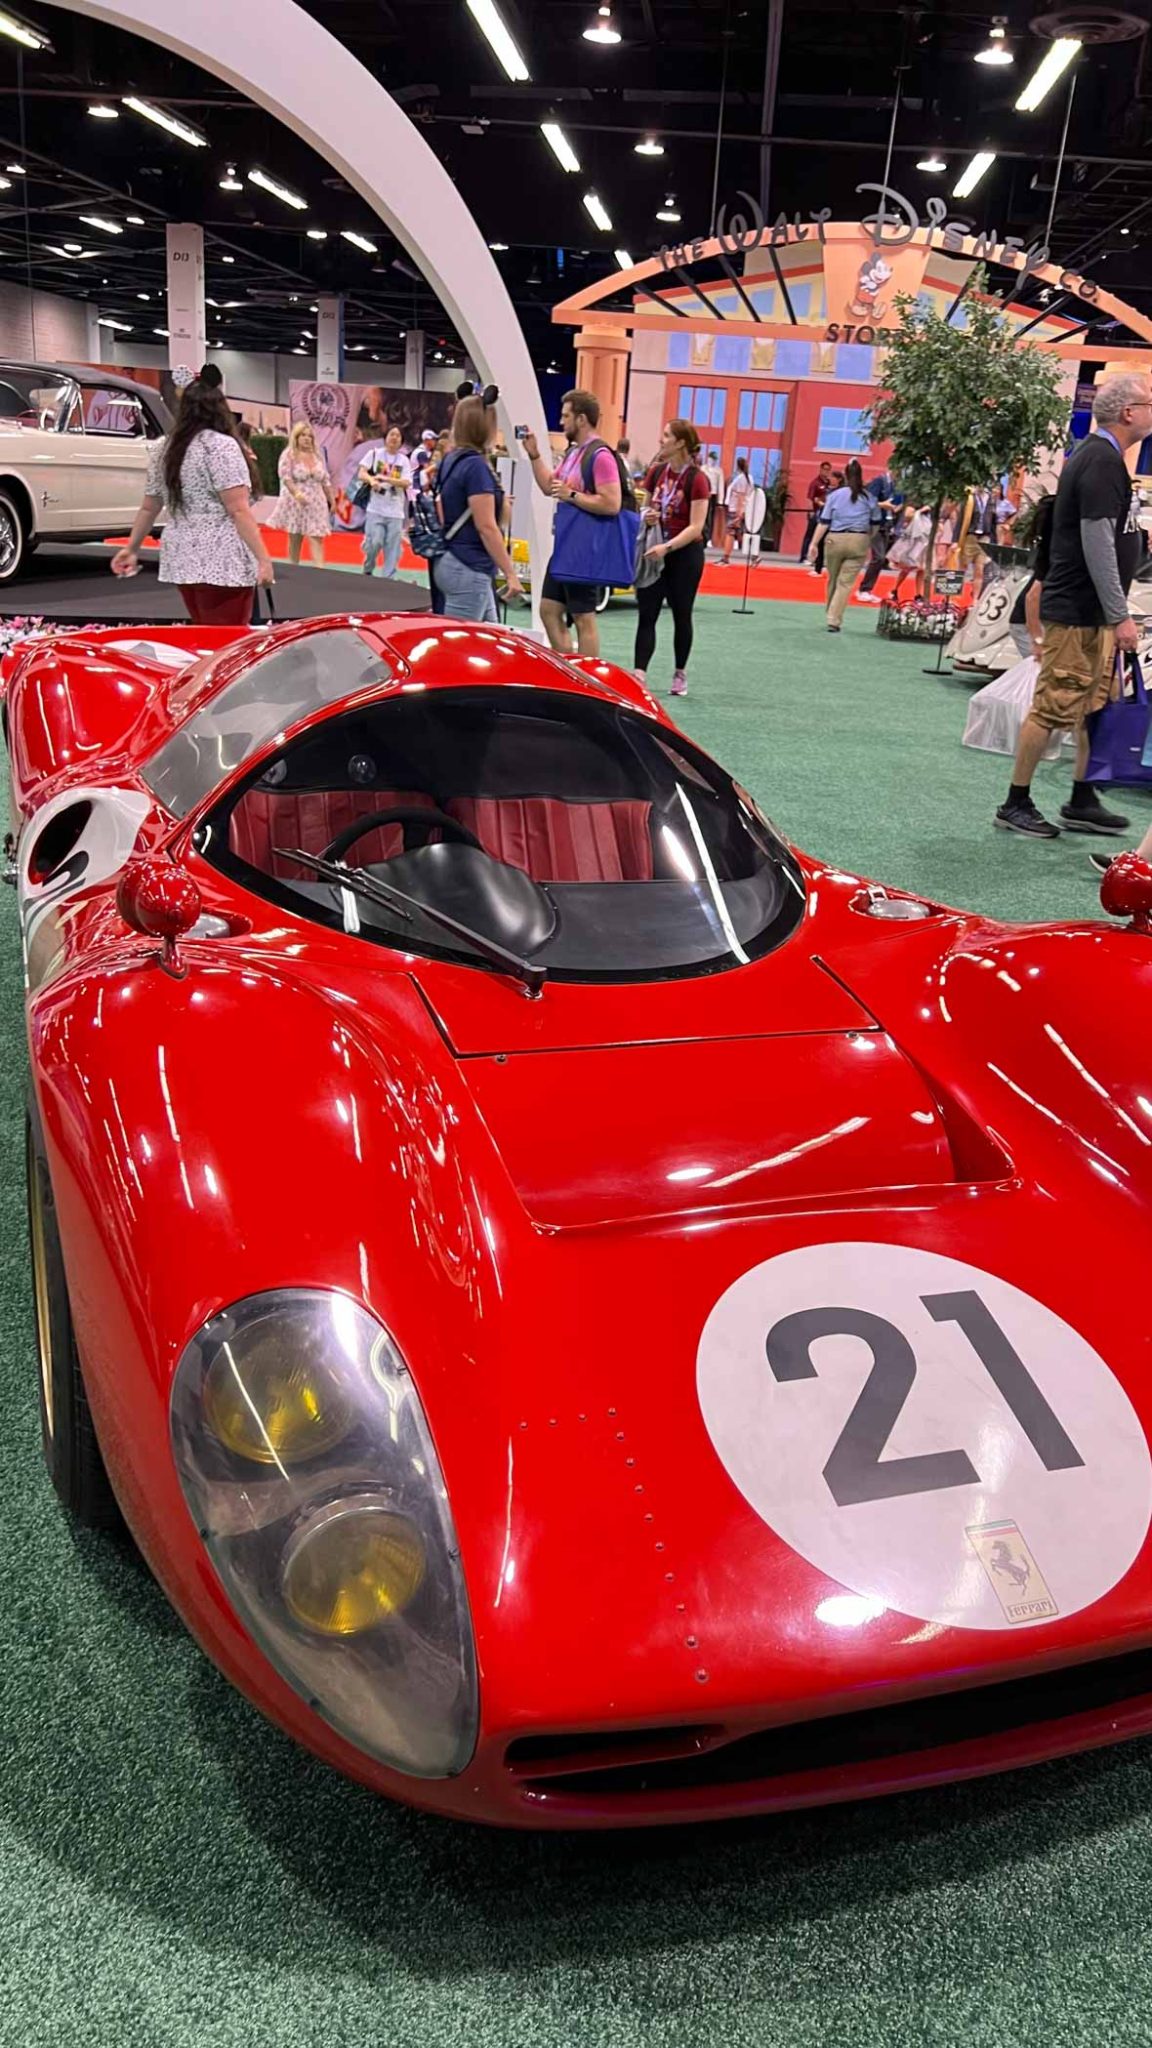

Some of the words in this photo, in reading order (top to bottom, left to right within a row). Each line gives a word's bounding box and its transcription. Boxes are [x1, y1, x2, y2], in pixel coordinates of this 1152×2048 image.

[653, 236, 704, 272] THE
[826, 323, 906, 346] STOR
[979, 592, 1008, 621] 53
[766, 1290, 1086, 1507] 21
[1007, 1598, 1053, 1618] Ferrari
